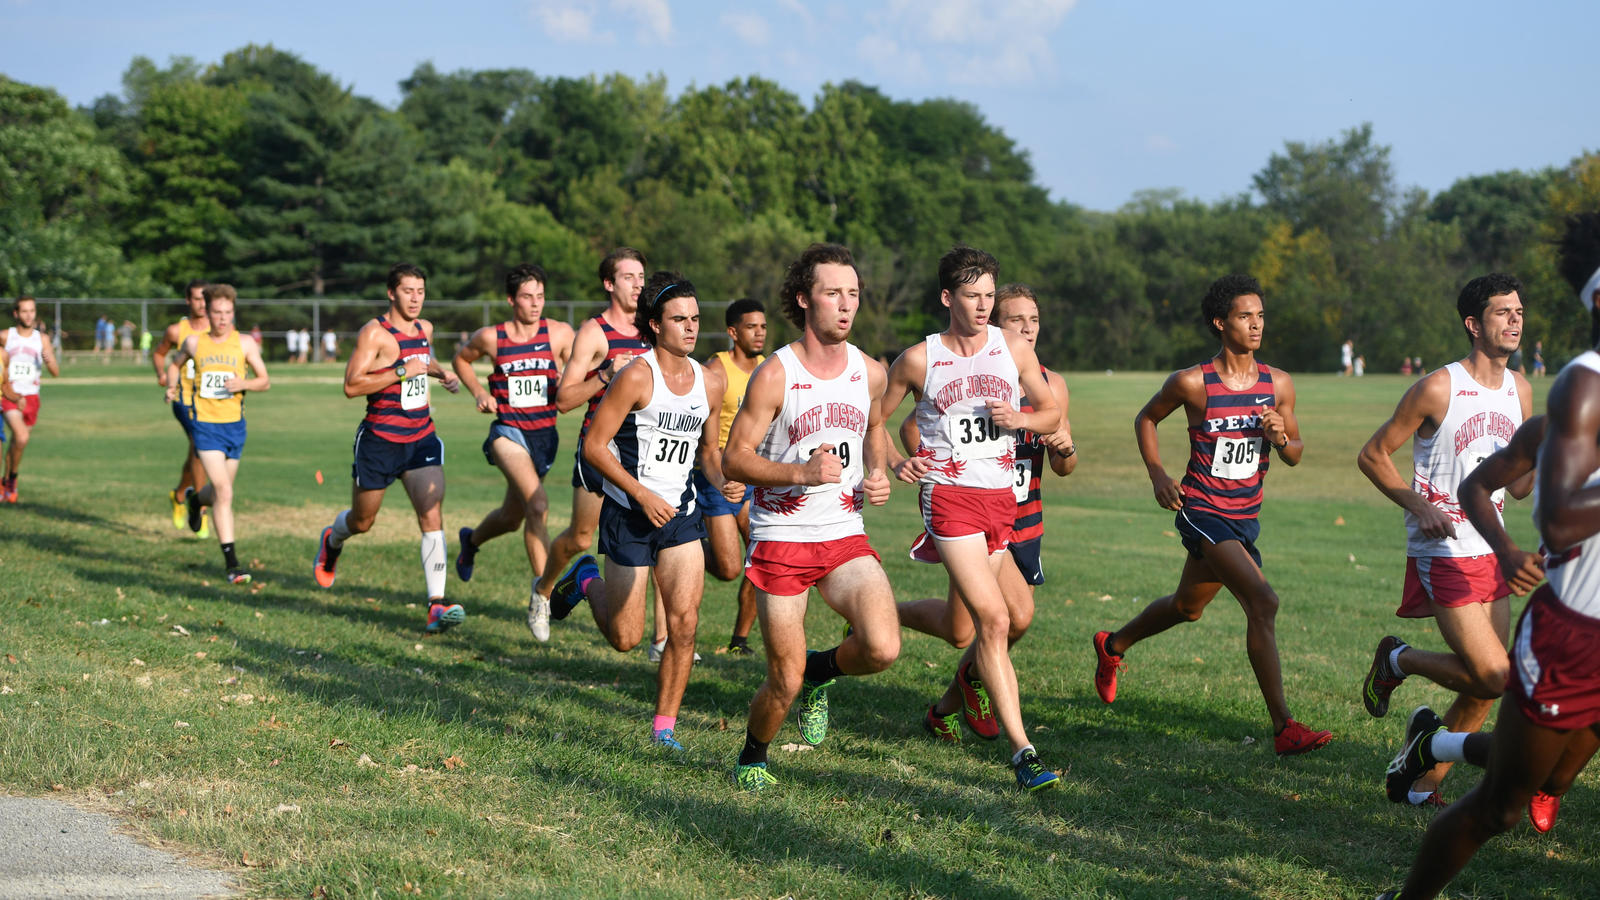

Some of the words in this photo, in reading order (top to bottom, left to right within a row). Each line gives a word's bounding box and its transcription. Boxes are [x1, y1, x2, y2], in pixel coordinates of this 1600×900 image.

[500, 358, 551, 375] PENN
[407, 377, 426, 397] 299
[514, 378, 542, 396] 304
[788, 405, 822, 446] SAINT
[959, 416, 1000, 444] 330
[1208, 414, 1264, 433] PEN
[1455, 412, 1485, 456] SAINT
[655, 438, 690, 465] 370
[1222, 441, 1256, 464] 305
